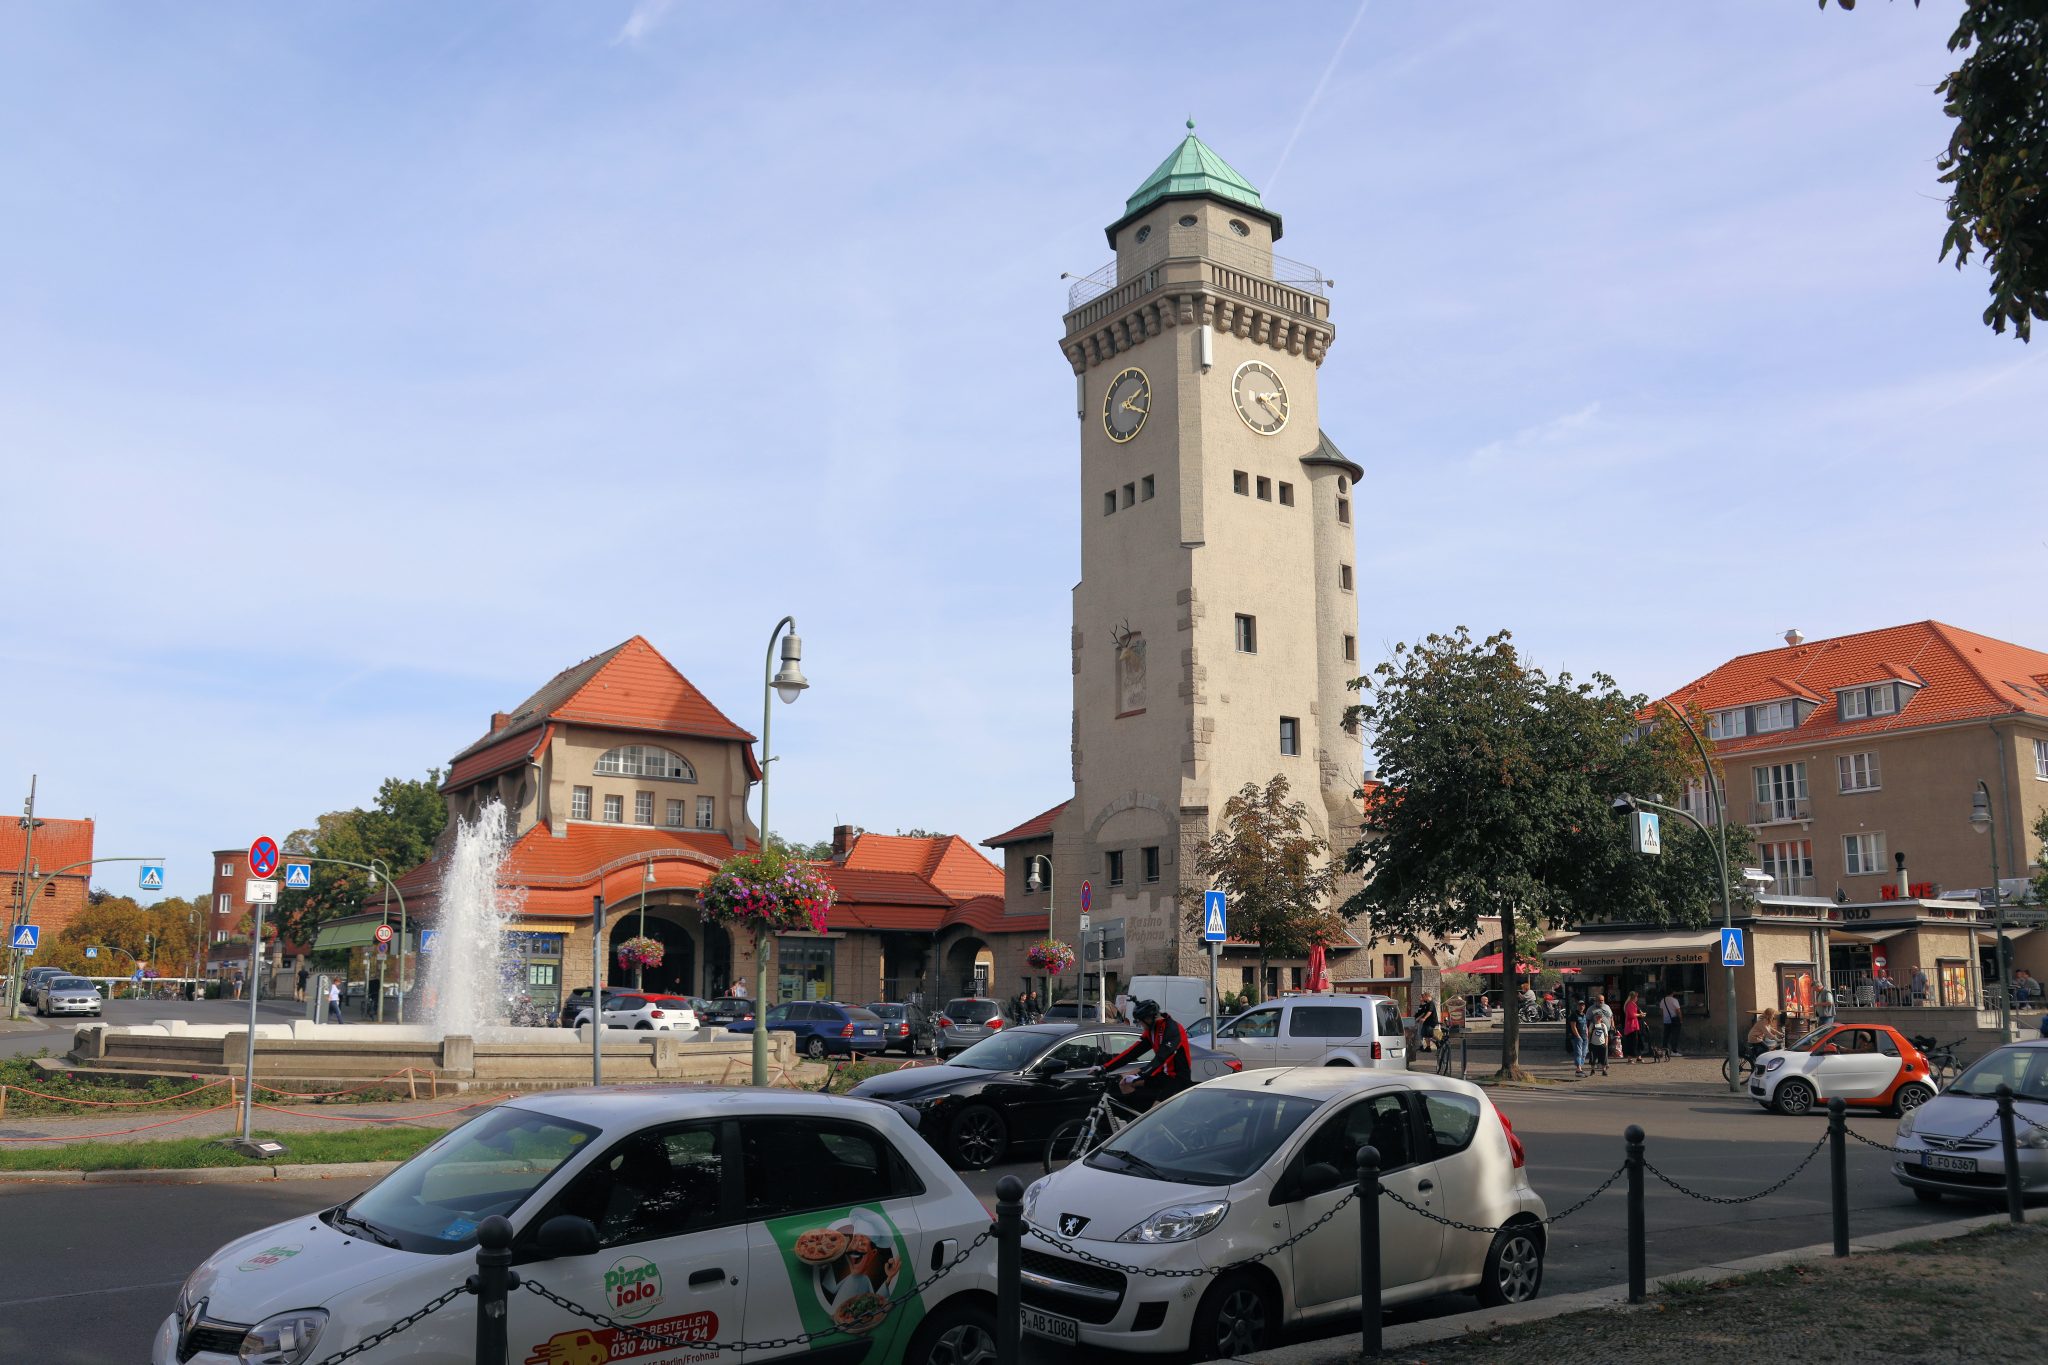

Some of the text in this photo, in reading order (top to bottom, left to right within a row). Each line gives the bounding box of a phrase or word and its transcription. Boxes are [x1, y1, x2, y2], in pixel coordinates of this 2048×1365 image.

[1842, 908, 1871, 920] IOLO
[379, 930, 390, 938] 30
[1548, 954, 1703, 967] Döner Hähnchen Currywurst Salate
[604, 1263, 657, 1292] Pizza
[616, 1281, 655, 1307] iolo
[650, 1315, 709, 1335] BESTELLEN
[1048, 1319, 1075, 1338] 1086
[610, 1343, 636, 1358] 030
[692, 1327, 708, 1340] 94
